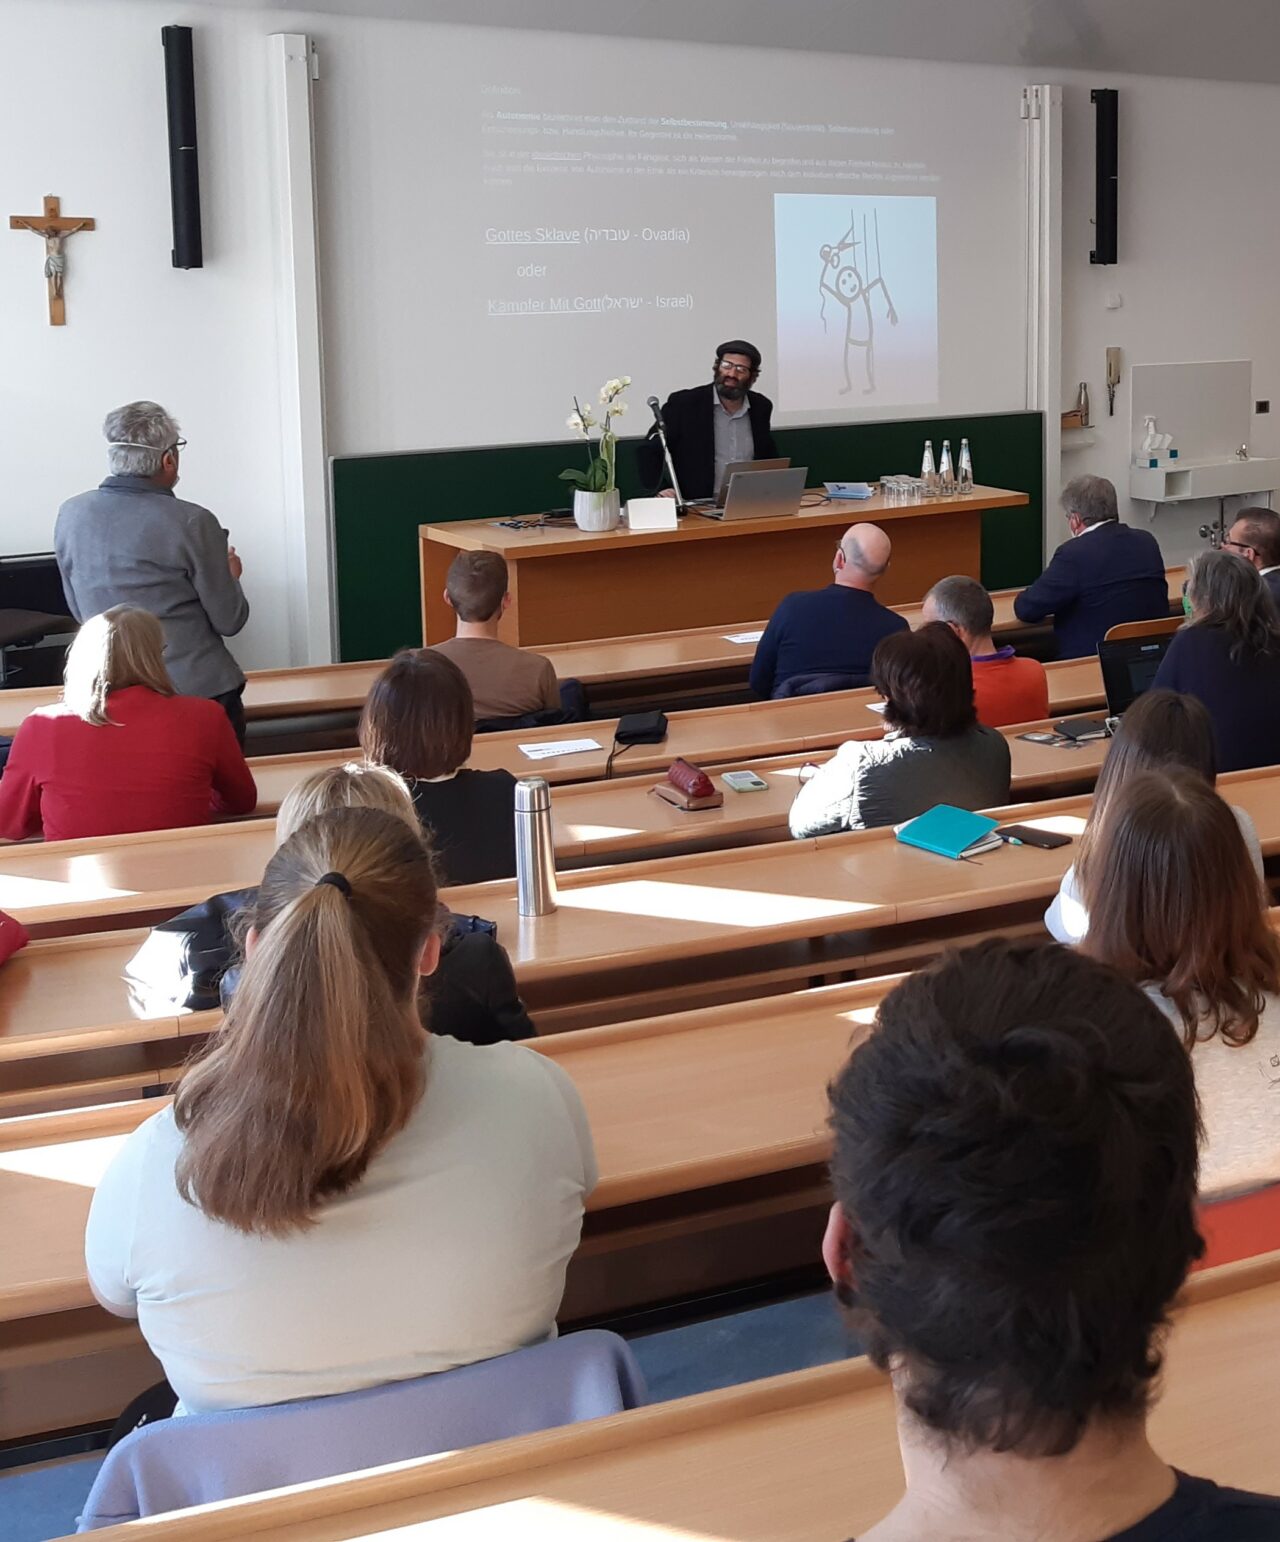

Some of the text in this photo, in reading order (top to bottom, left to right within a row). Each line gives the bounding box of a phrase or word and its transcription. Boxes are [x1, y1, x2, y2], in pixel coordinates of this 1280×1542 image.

[485, 227, 532, 242] Gottes
[535, 227, 581, 242] Sklave
[641, 227, 691, 244] Ovadia)
[516, 263, 547, 277] oder
[549, 297, 570, 312] Mit
[655, 294, 694, 311] Israel)
